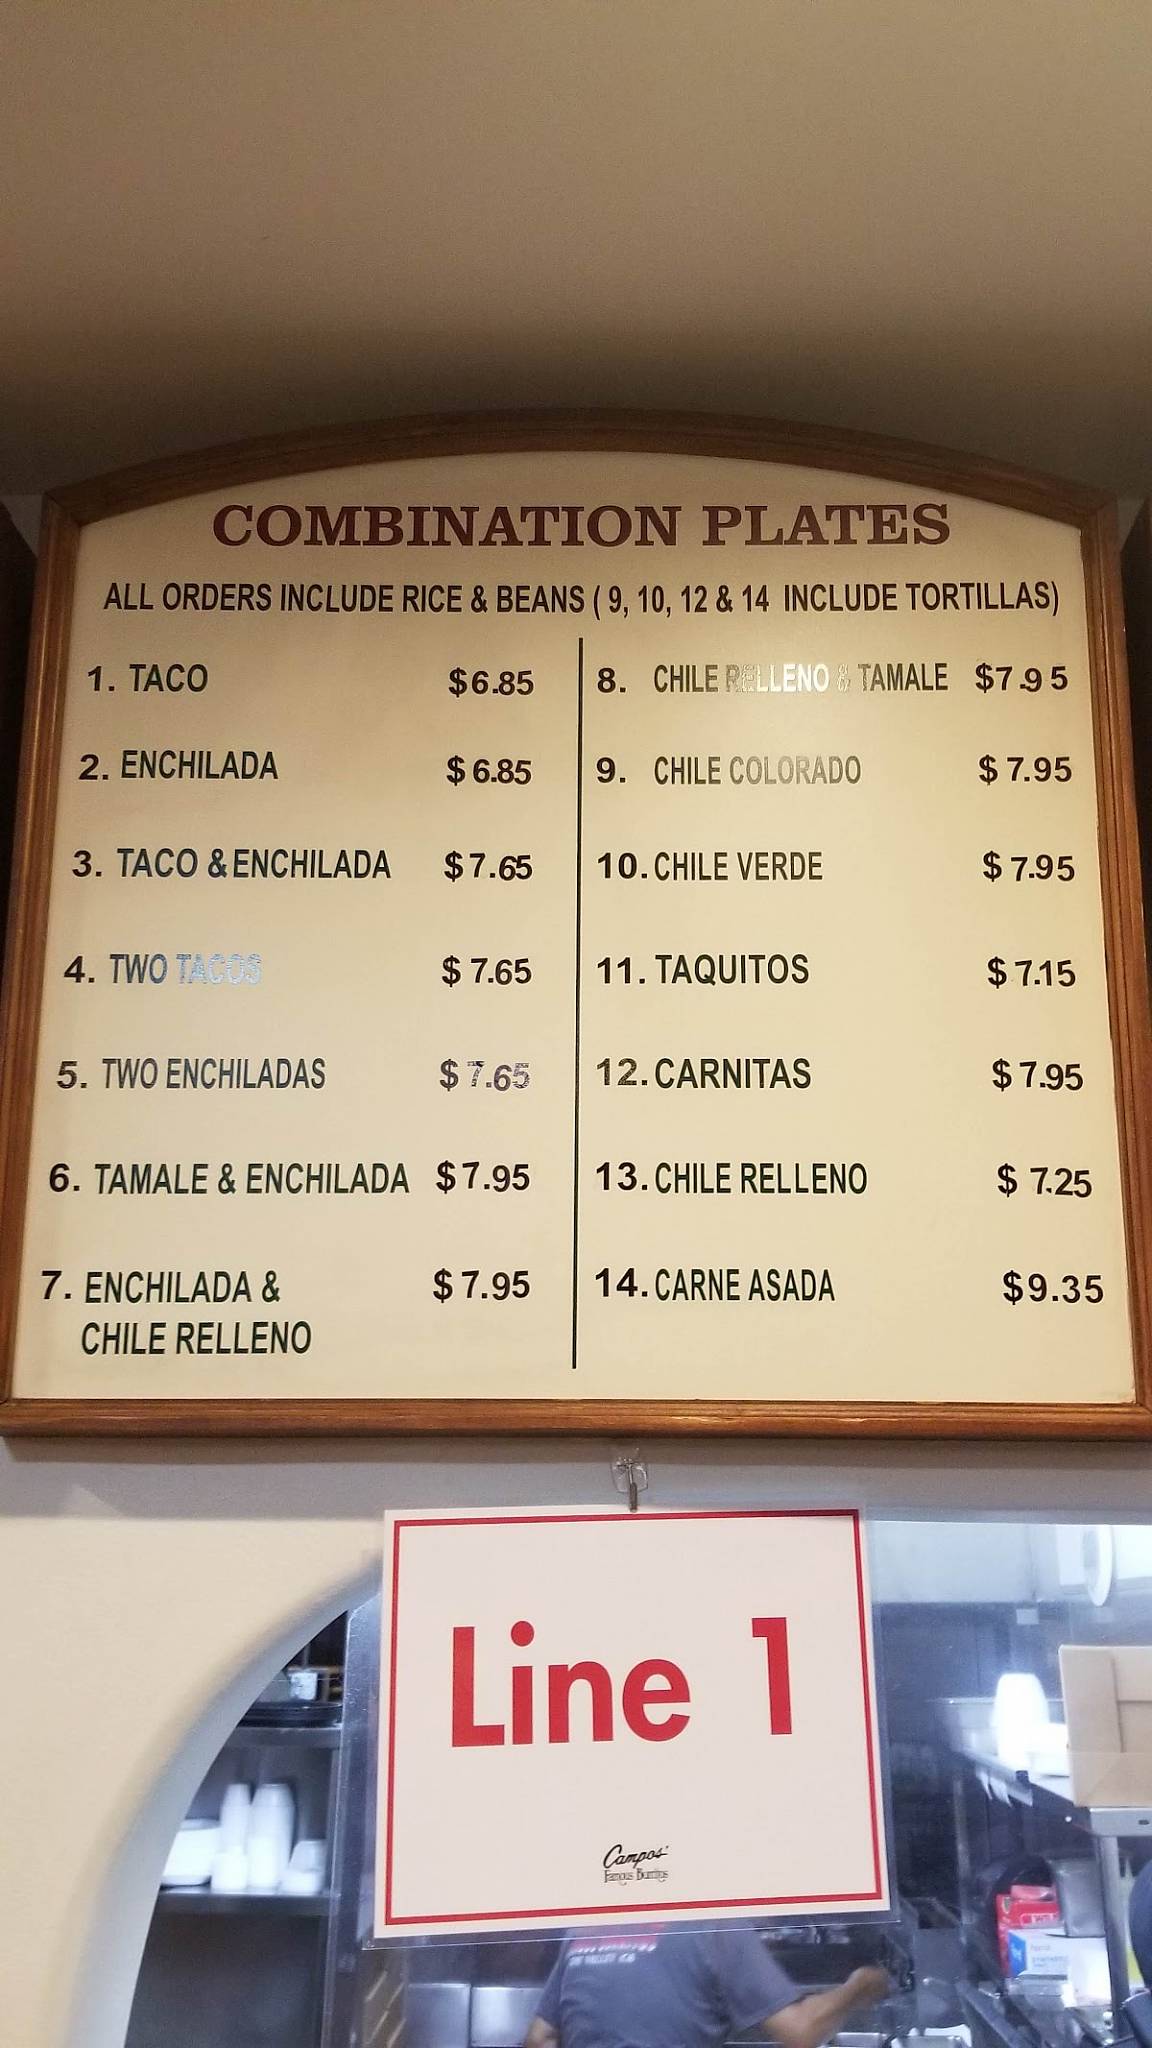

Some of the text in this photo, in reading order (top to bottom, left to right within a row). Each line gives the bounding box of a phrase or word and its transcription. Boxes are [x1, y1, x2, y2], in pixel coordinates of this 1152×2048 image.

[213, 503, 949, 547] COMBINATION PLATES
[104, 583, 153, 610] ALL
[163, 583, 271, 611] ORDERS
[281, 584, 393, 612] INCLUDE
[403, 585, 462, 612] RICE
[471, 585, 487, 613] &
[497, 585, 584, 613] BEANS
[639, 585, 670, 617] 10,
[681, 586, 707, 612] 12
[716, 585, 733, 612] &
[743, 585, 769, 611] 14
[785, 584, 897, 611] INCLUDE
[906, 581, 1058, 616] TORTILLAS)
[88, 664, 207, 692] 1. TACO
[598, 668, 626, 693] 8.
[654, 665, 718, 692] CHILE
[726, 663, 830, 692] RELLENO
[858, 663, 948, 691] TAMALE
[79, 750, 278, 780] 2. ENCHILADA
[597, 756, 860, 784] 9. CHILE COLORADO
[72, 850, 101, 877] 3.
[117, 848, 197, 877] TACO
[598, 852, 822, 880] 10. CHILE VERDE
[64, 953, 262, 984] 4. TWO TACOS
[598, 954, 808, 985] 11. TAQUITOS
[57, 1058, 325, 1089] 5. TWO ENCHILADAS
[597, 1058, 810, 1088] 12. CARNITAS
[50, 1163, 409, 1194] 6. TAMALE & ENCHILADA
[597, 1162, 867, 1194] 13. CHILE RELLENO
[42, 1271, 280, 1303] 7. ENCHILADA &
[596, 1268, 835, 1301] 14. CARNE ASADA
[82, 1321, 311, 1354] CHILE RELLENO
[452, 1617, 792, 1747] Line 1
